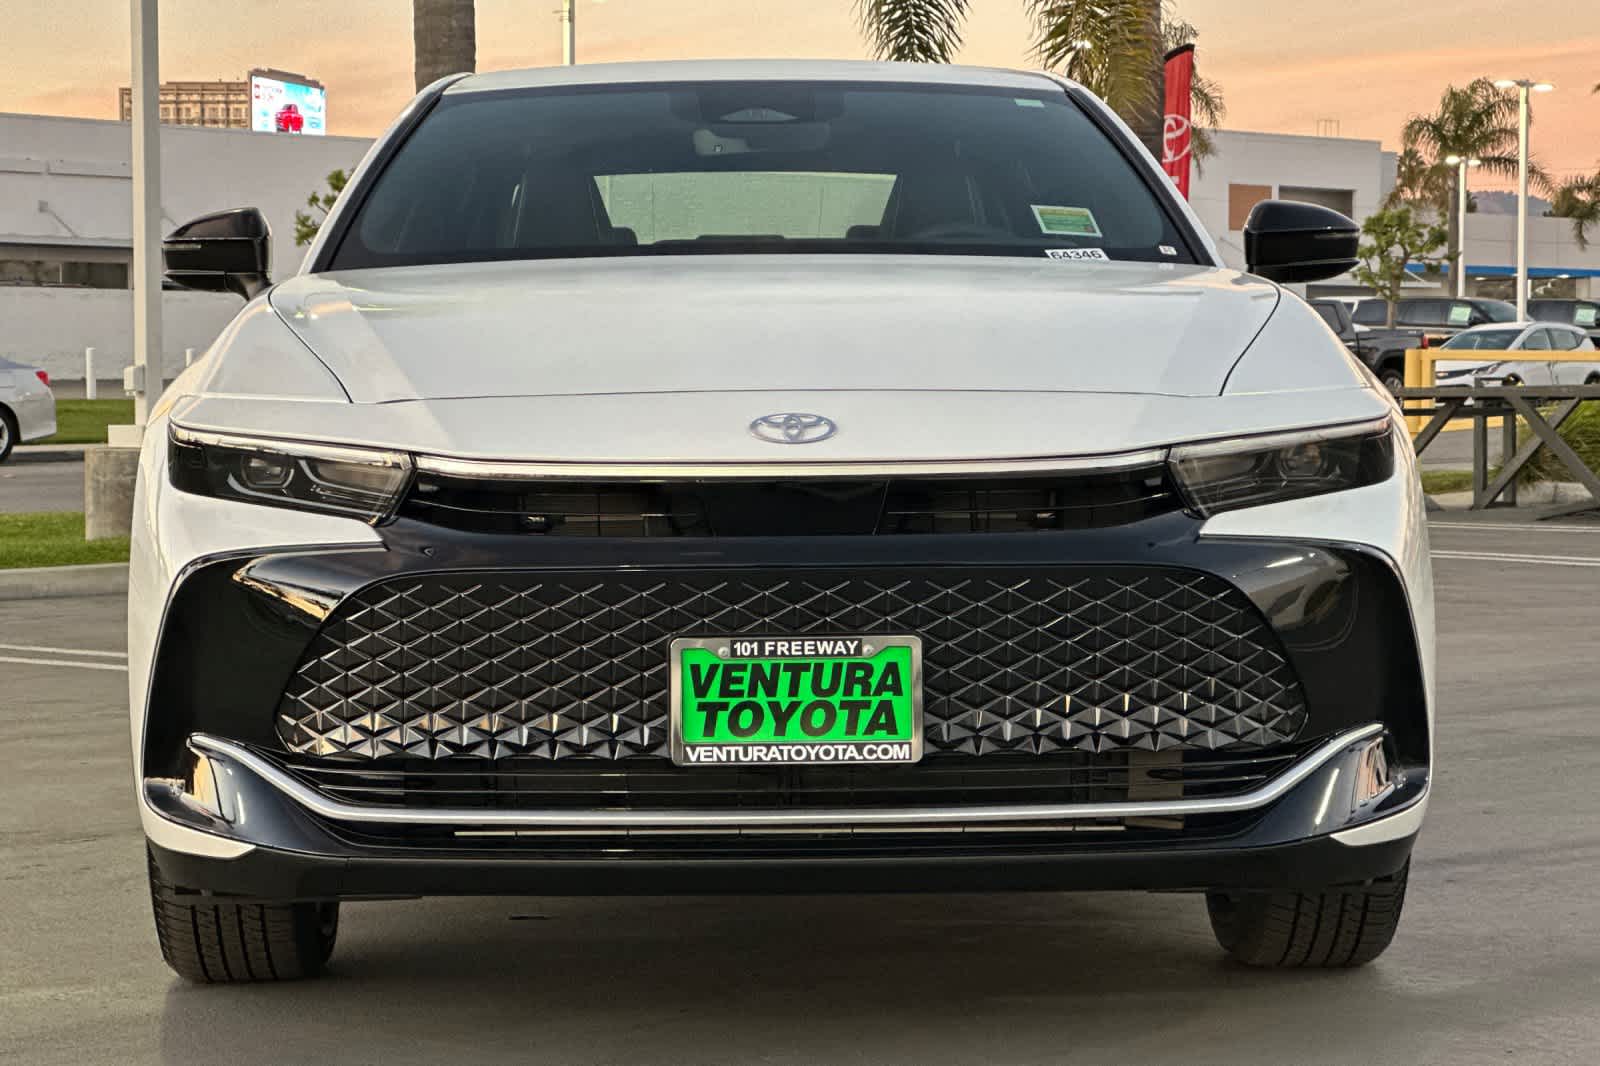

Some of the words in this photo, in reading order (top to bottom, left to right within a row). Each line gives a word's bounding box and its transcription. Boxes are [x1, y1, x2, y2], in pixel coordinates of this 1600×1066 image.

[733, 641, 759, 656] 101
[764, 640, 858, 656] FREEWAY
[689, 662, 903, 698] VENTURA
[696, 700, 898, 737] TOYOTA
[686, 744, 910, 762] VENTURATOYOTA.COM
